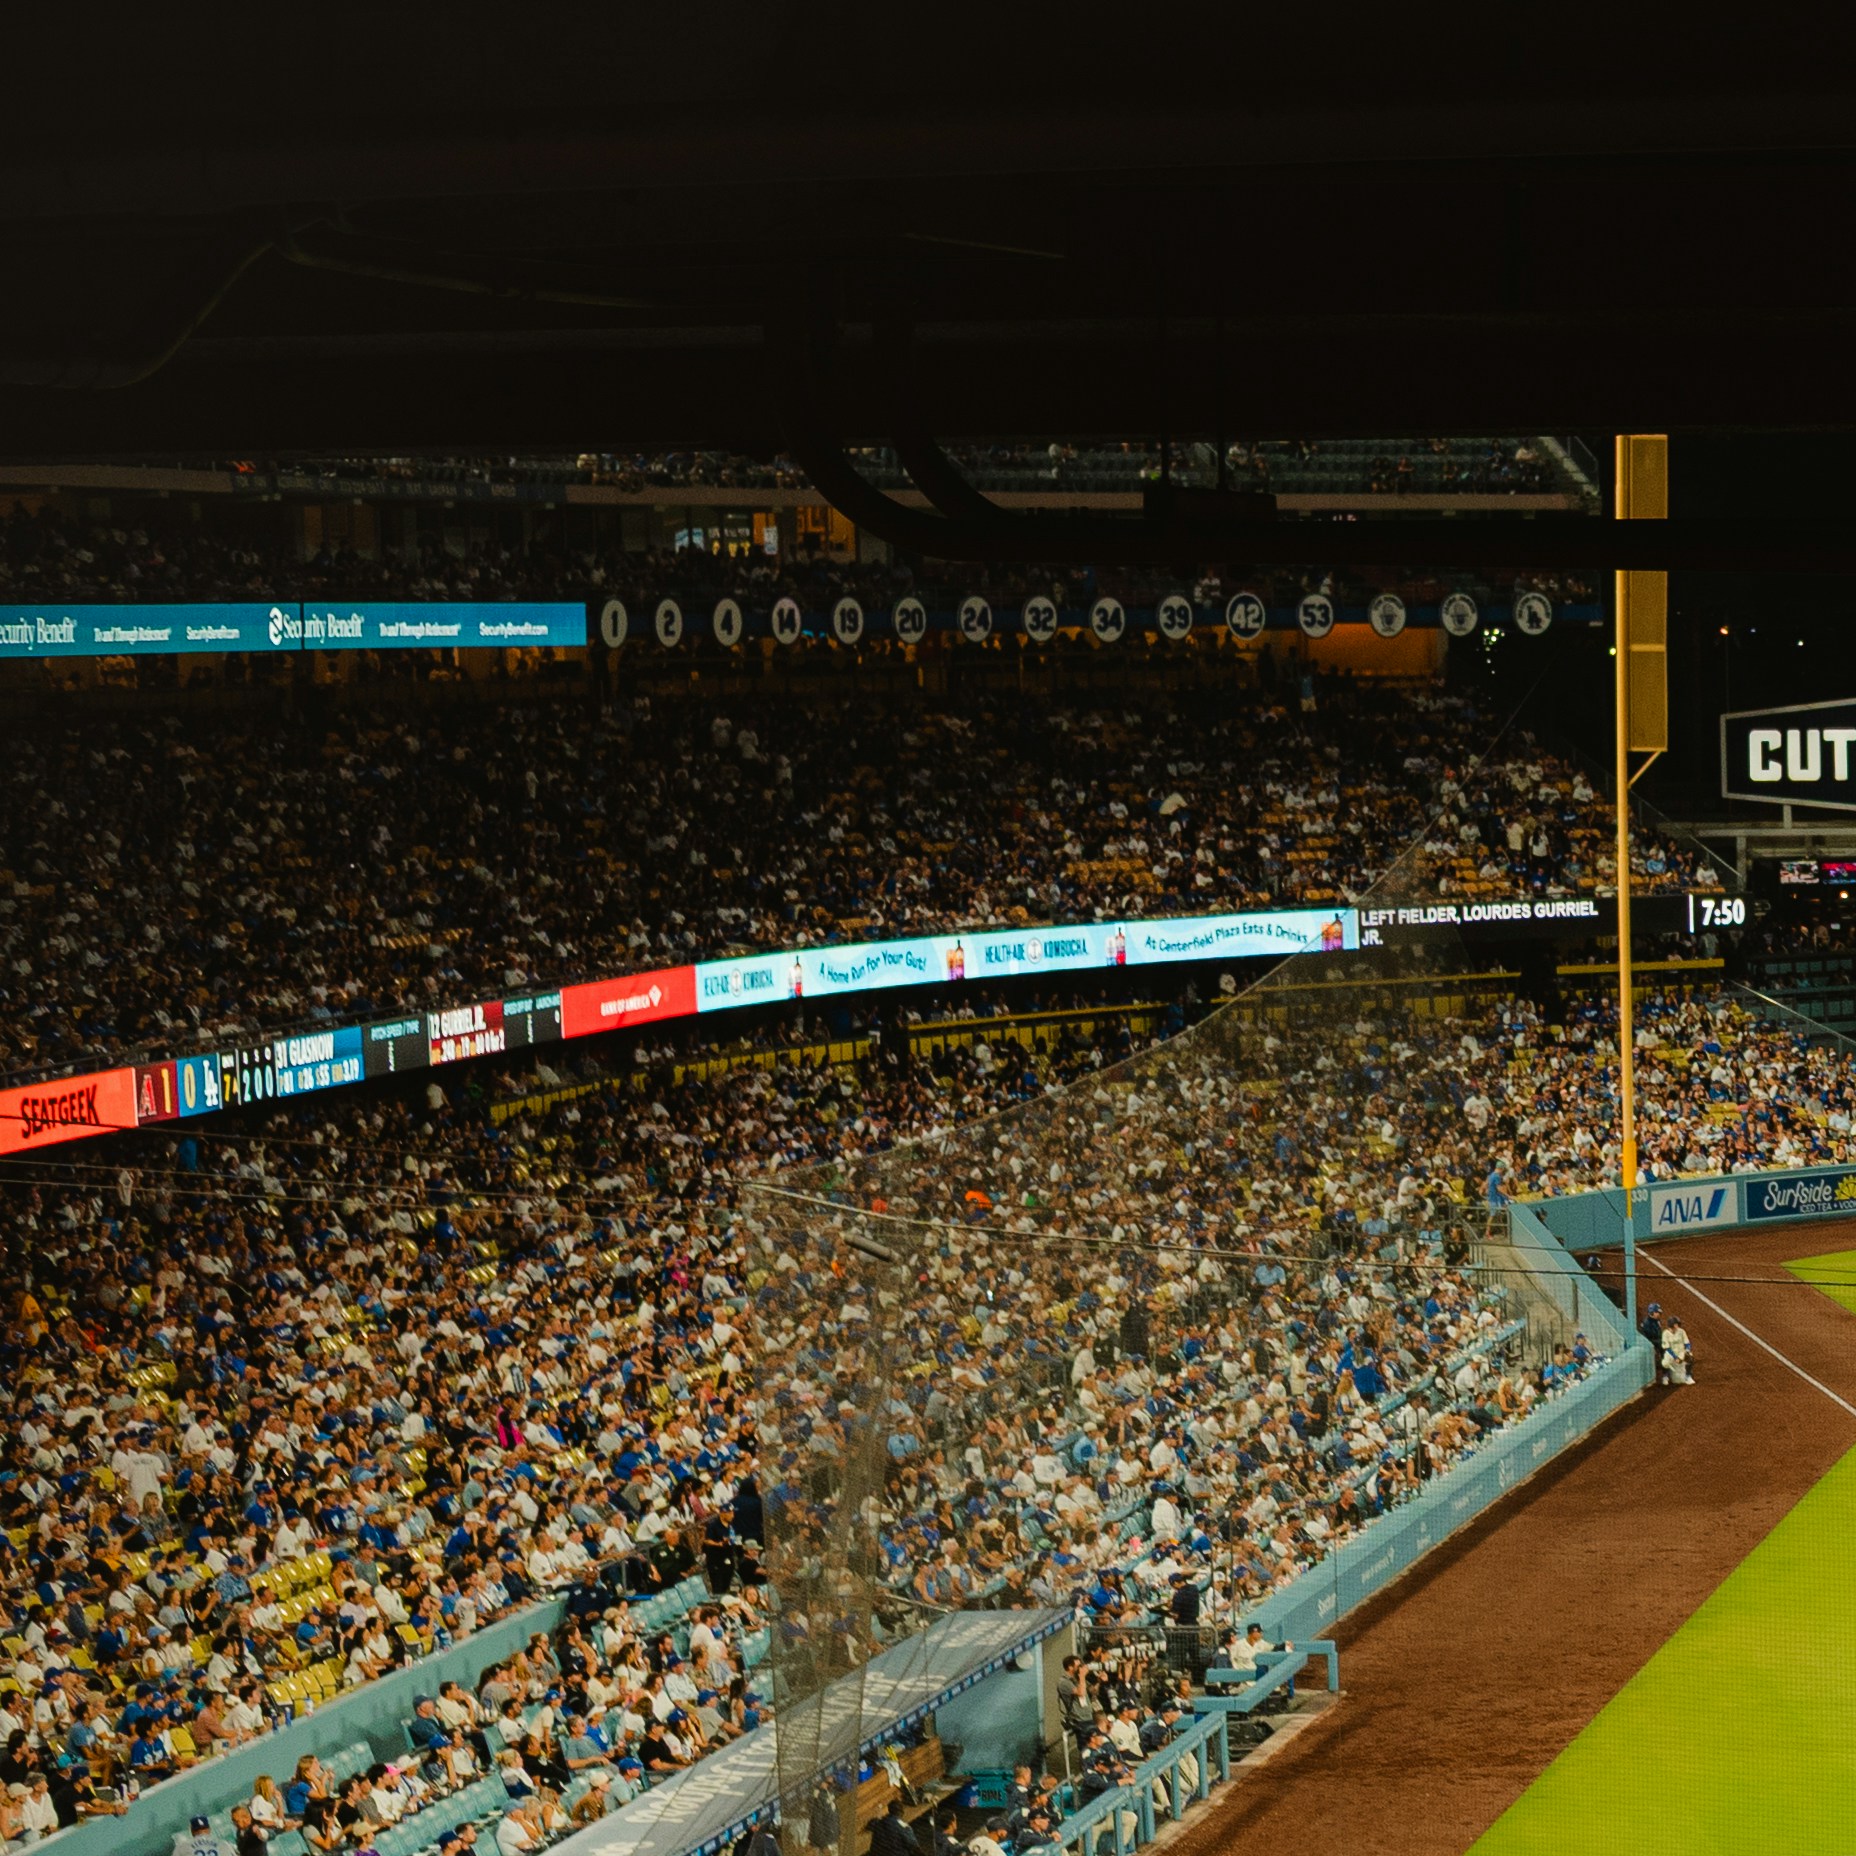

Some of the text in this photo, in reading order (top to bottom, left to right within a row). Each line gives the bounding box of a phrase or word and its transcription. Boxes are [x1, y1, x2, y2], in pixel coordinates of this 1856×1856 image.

[327, 613, 363, 637] Benefit
[611, 611, 619, 638] 1
[663, 610, 676, 636] 2
[721, 609, 734, 635] 4
[777, 608, 797, 634] 14
[838, 608, 858, 634] 19
[899, 608, 925, 633] 20
[963, 607, 989, 632] 24
[1027, 606, 1055, 632] 32
[1095, 606, 1123, 632] 34
[1163, 605, 1190, 631] 39
[1232, 604, 1261, 630] 42
[1303, 603, 1330, 627] 53
[37, 616, 76, 644] Benefit
[1361, 900, 1598, 927] LEFT FIELDER, LOURDES GURRIEL
[1701, 900, 1745, 926] 7:50
[1145, 923, 1308, 953] At Centerfield Plaza Eats Drinks
[1361, 929, 1383, 946] JR.
[826, 951, 927, 983] Home Run Your Gut!
[601, 994, 650, 1016] BANK AMERICA
[289, 1033, 334, 1066] GLASNOW
[161, 1064, 196, 1113] 1 0
[243, 1065, 274, 1102] 2 0 0
[21, 1085, 99, 1138] SEATGEEK
[1764, 1180, 1832, 1212] Surfside
[1817, 1202, 1832, 1213] TEA
[1658, 1194, 1703, 1226] ANA
